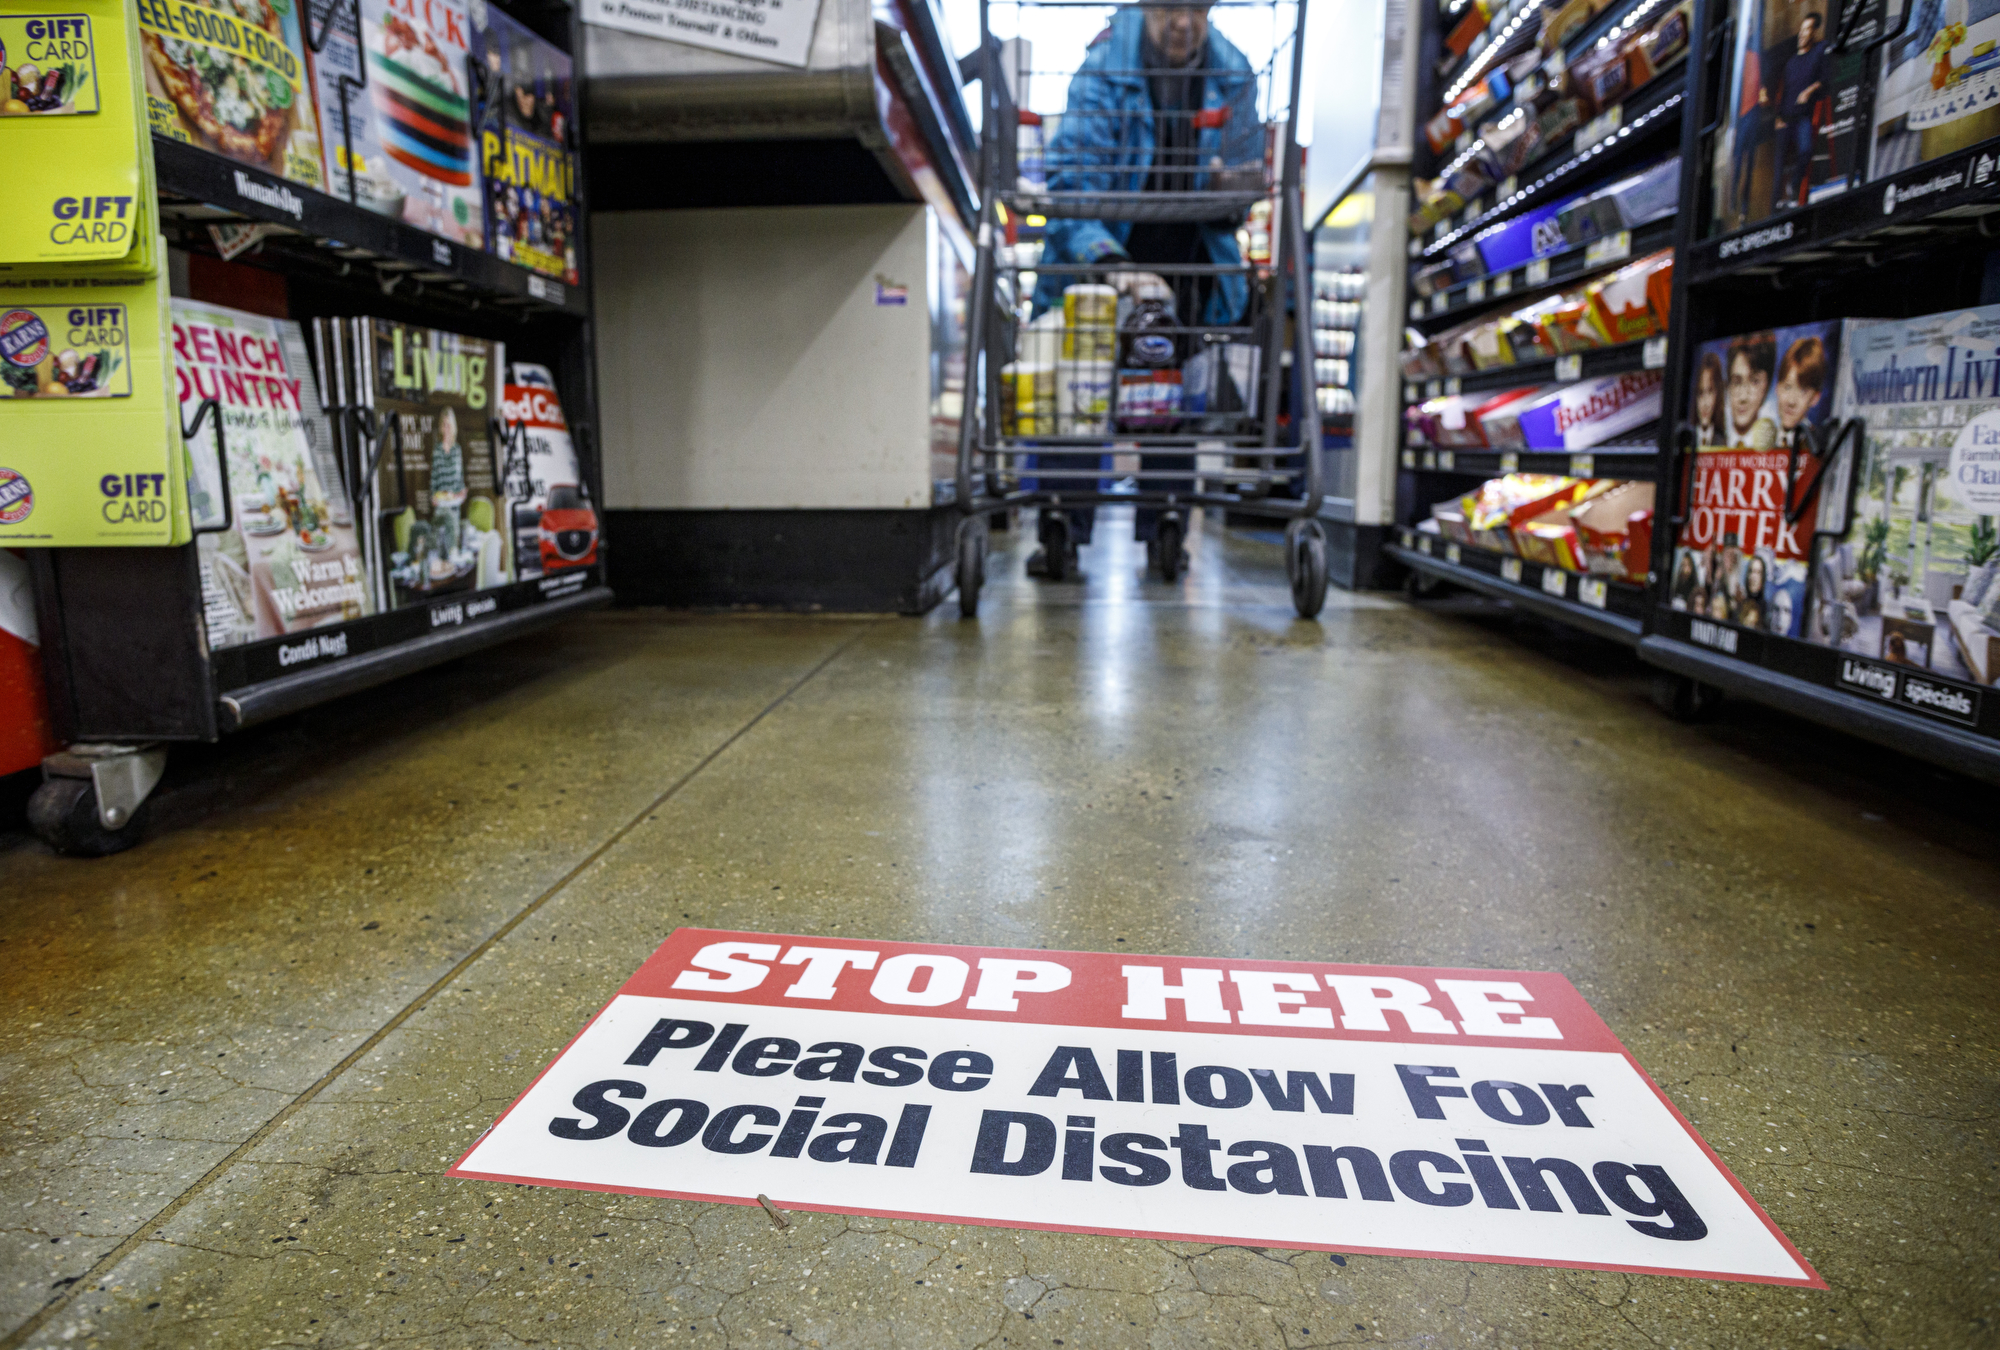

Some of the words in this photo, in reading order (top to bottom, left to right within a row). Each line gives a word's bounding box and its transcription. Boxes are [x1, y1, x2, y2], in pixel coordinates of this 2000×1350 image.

[26, 19, 85, 39] GIFT
[737, 27, 779, 48] Others
[26, 41, 89, 61] CARD
[242, 25, 296, 79] FOOD
[53, 196, 133, 220] GIFT
[50, 222, 127, 245] CARD
[68, 309, 121, 326] GIFT
[67, 328, 124, 347] CARD
[393, 327, 487, 410] Living
[1853, 353, 1939, 405] Southern
[100, 473, 165, 497] GIFT
[102, 500, 166, 524] CARD
[291, 560, 344, 583] Warm
[271, 580, 367, 614] Welcoming
[431, 602, 463, 627] Living
[1842, 660, 1896, 699] Living
[1904, 687, 1972, 714] specials
[671, 941, 1072, 1012] STOP
[1121, 964, 1563, 1040] HERE
[623, 1018, 995, 1093] Please
[1026, 1046, 1355, 1116] Allow
[1393, 1063, 1595, 1128] For
[548, 1079, 932, 1168] Social
[970, 1108, 1708, 1242] Distancing
